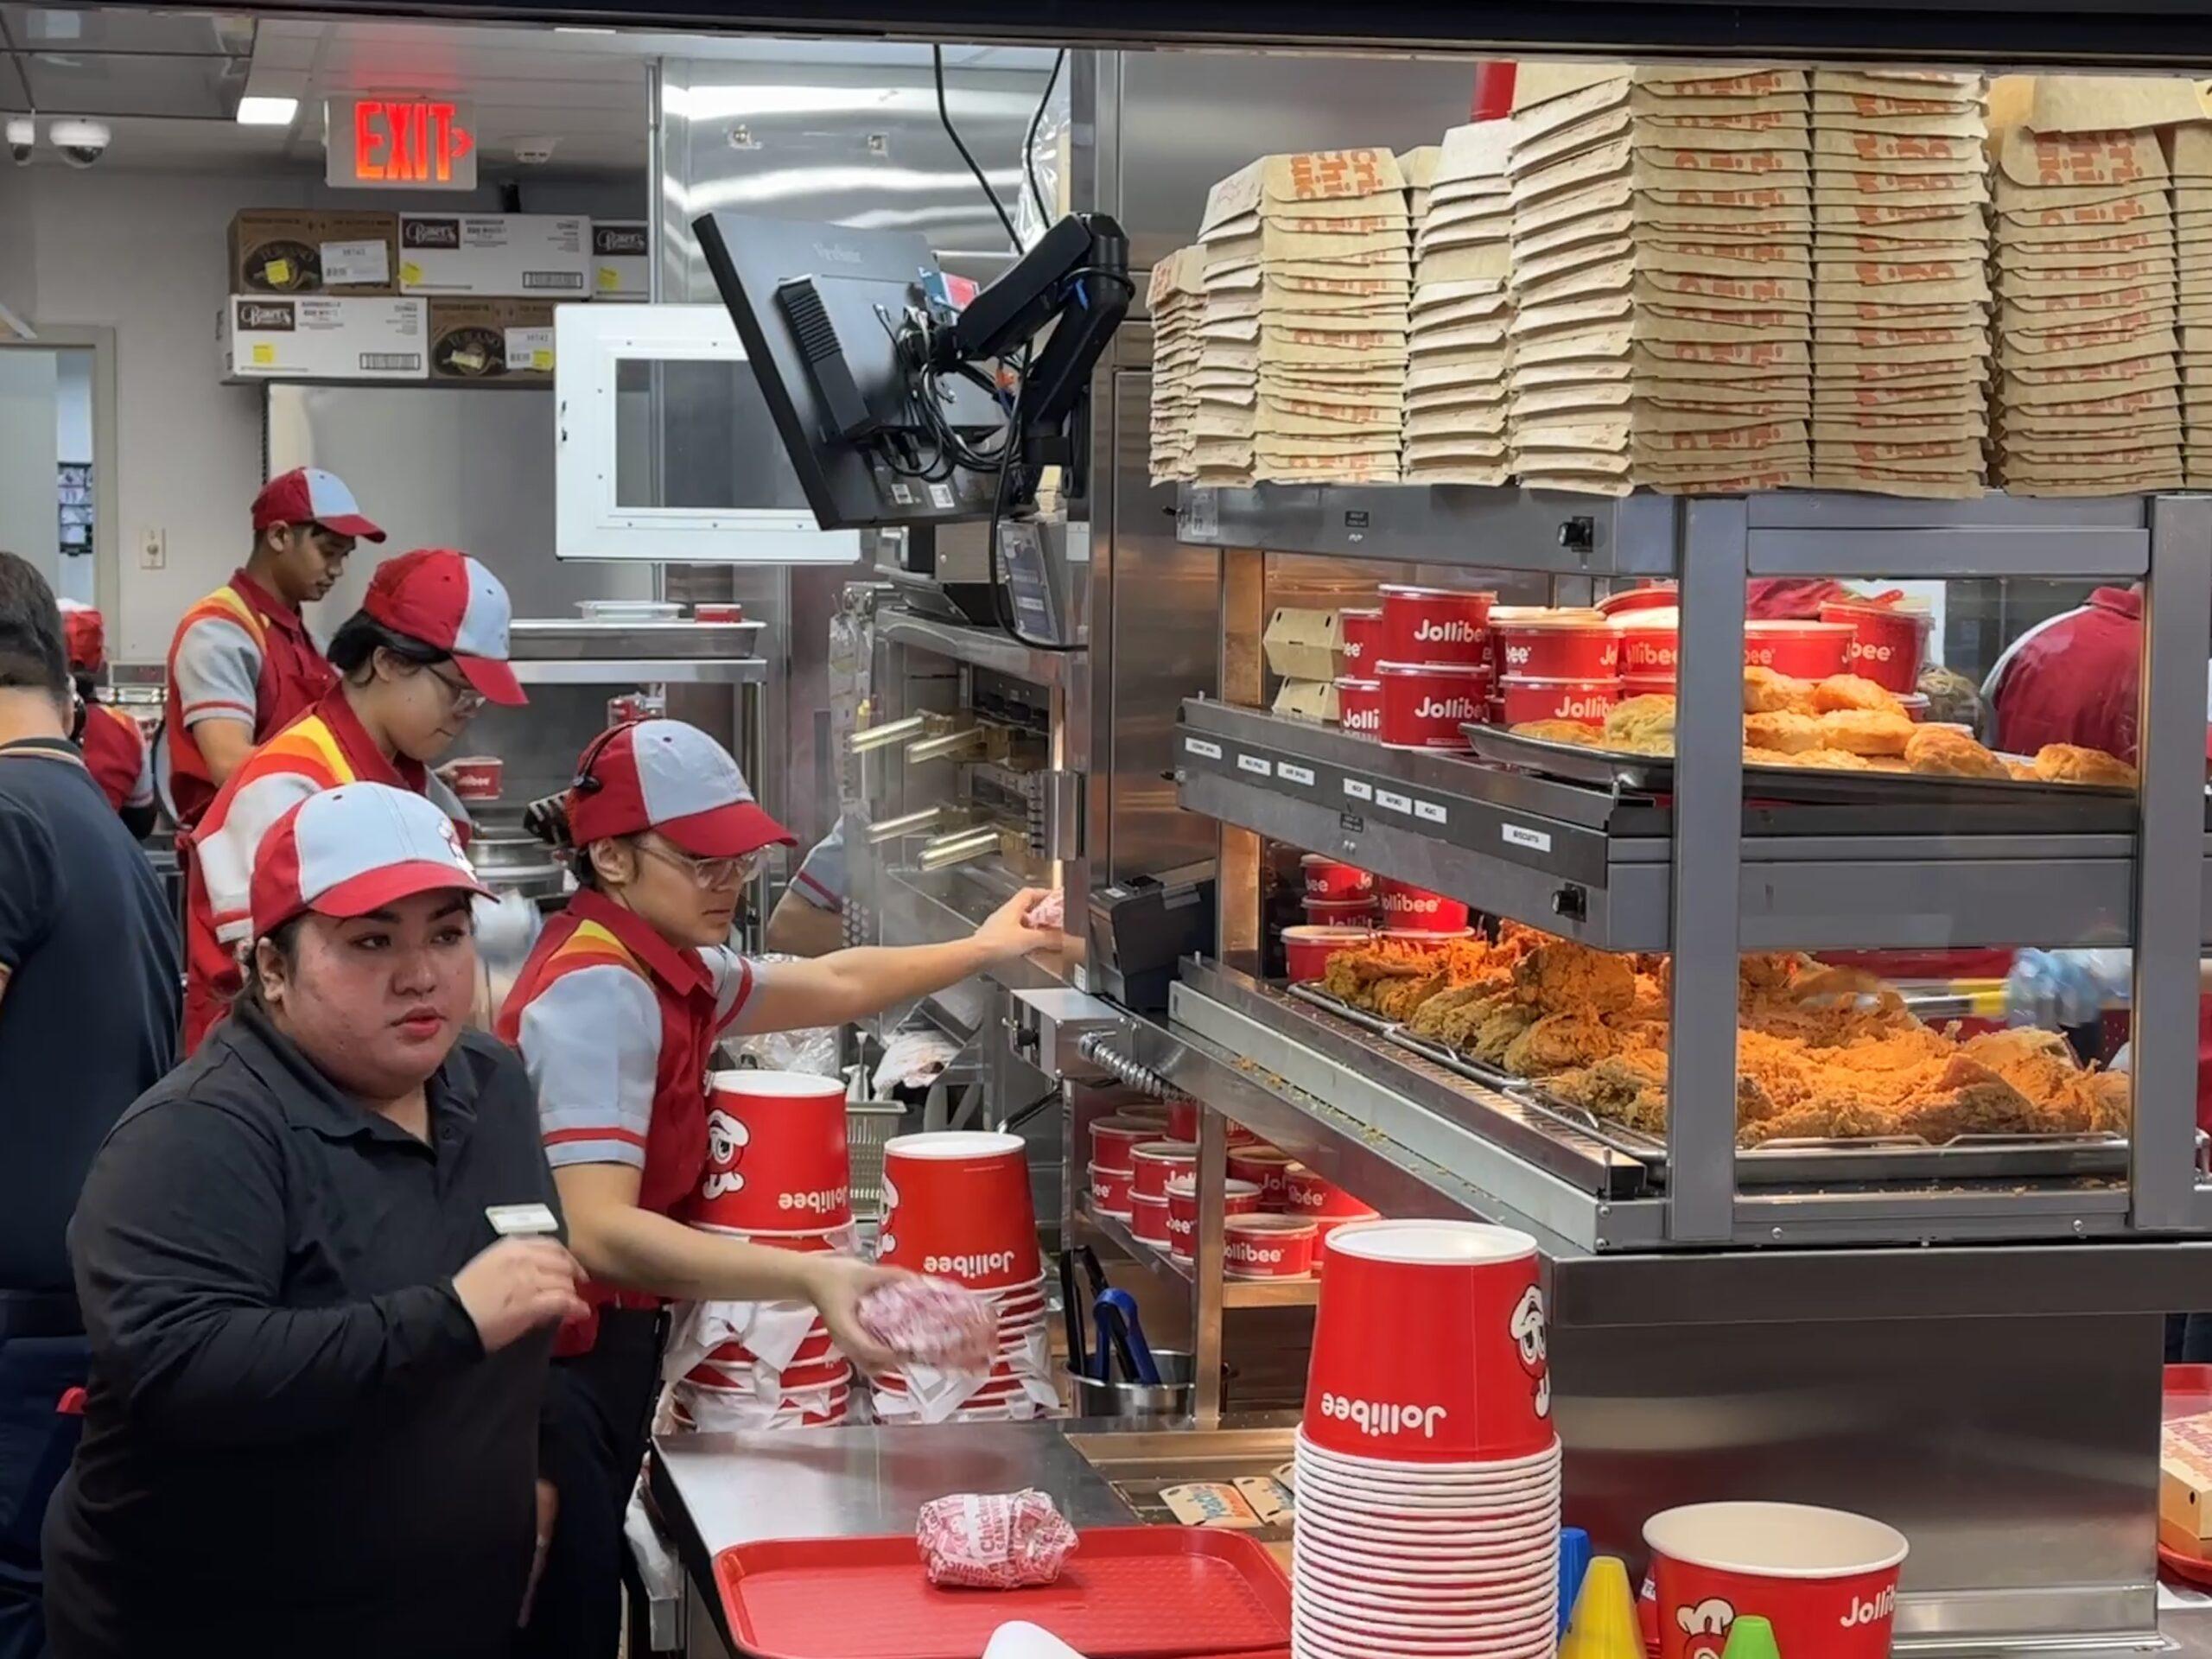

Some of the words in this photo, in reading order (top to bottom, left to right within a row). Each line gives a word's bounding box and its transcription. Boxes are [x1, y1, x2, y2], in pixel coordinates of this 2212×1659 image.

[355, 101, 455, 181] EXIT
[1414, 619, 1485, 643] Jollibe
[1343, 709, 1380, 729] Jolli
[1382, 893, 1439, 913] ollibee
[779, 1185, 848, 1213] Jollibee
[924, 1251, 1014, 1279] Jollibee
[1224, 1242, 1282, 1263] ollibee
[1321, 1392, 1447, 1438] Jollibee
